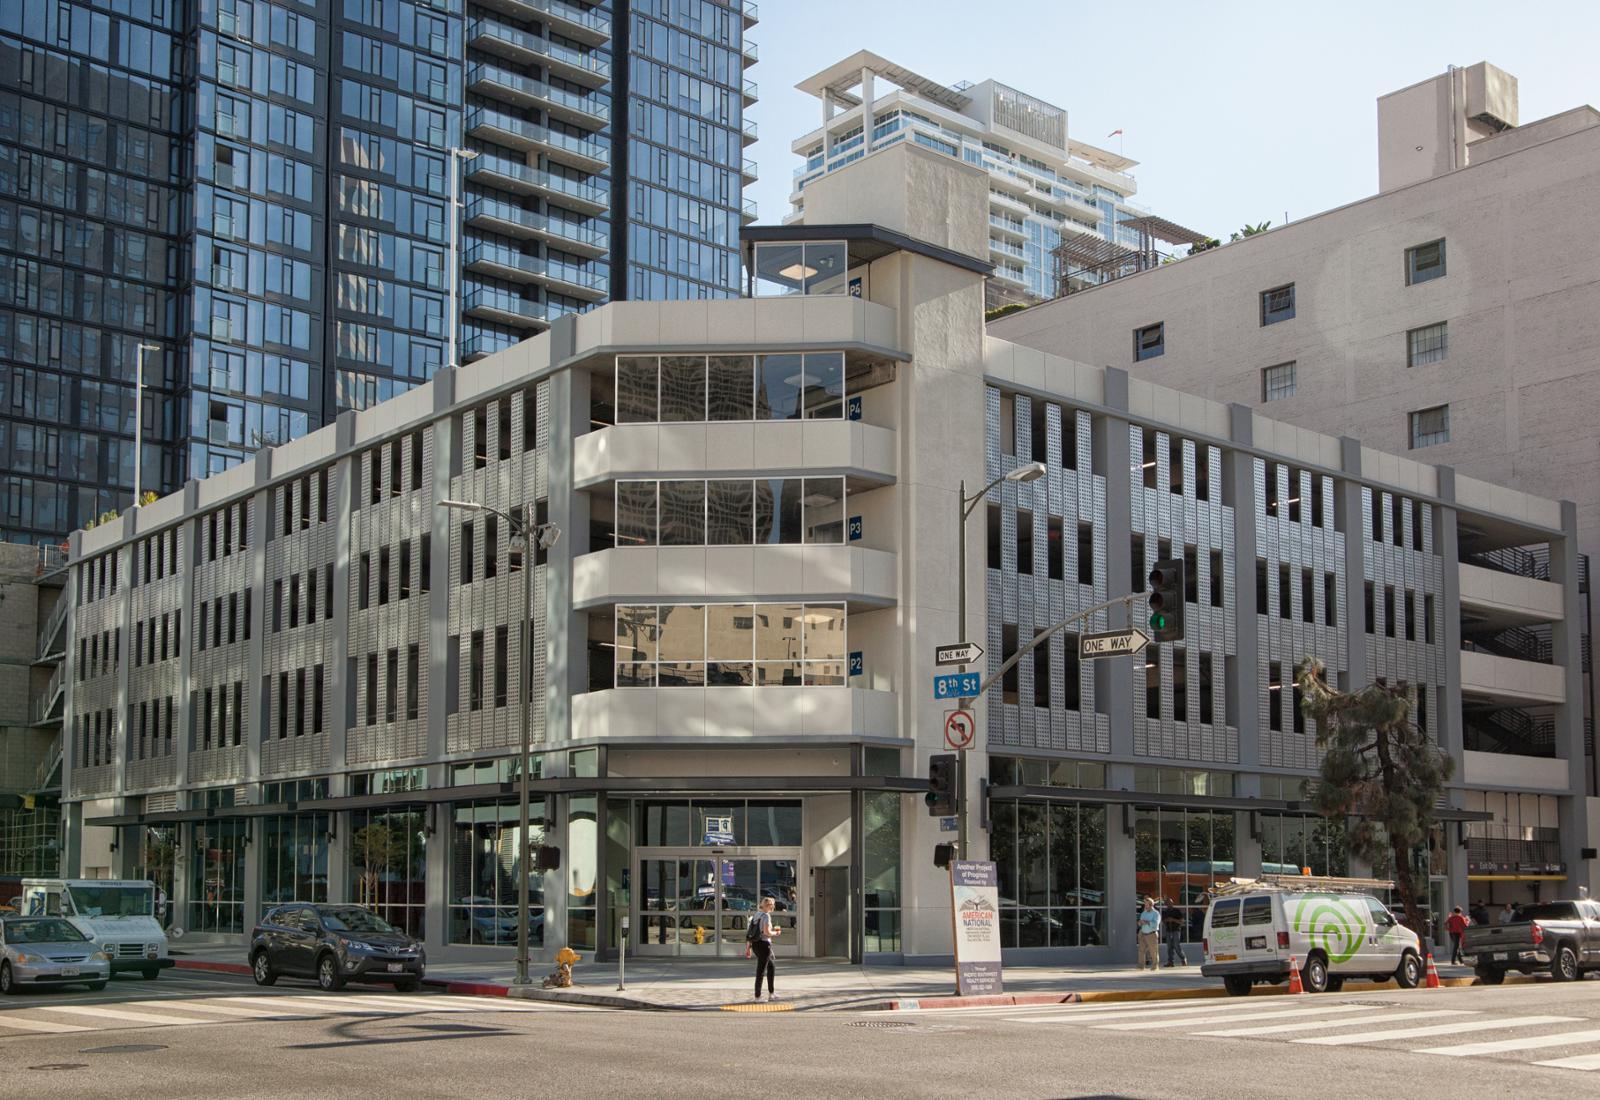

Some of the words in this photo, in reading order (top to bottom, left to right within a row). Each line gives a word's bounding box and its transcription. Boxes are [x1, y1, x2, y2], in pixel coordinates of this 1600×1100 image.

[850, 283, 861, 296] P5
[850, 402, 860, 416] P4
[850, 522, 861, 535] P3
[1084, 640, 1104, 651] ONE
[1110, 636, 1132, 649] WAY
[940, 651, 953, 660] ONE
[955, 649, 969, 658] WAY
[851, 657, 862, 670] P2
[938, 677, 958, 695] 8th
[963, 678, 976, 691] St
[963, 919, 993, 927] NATIONAL
